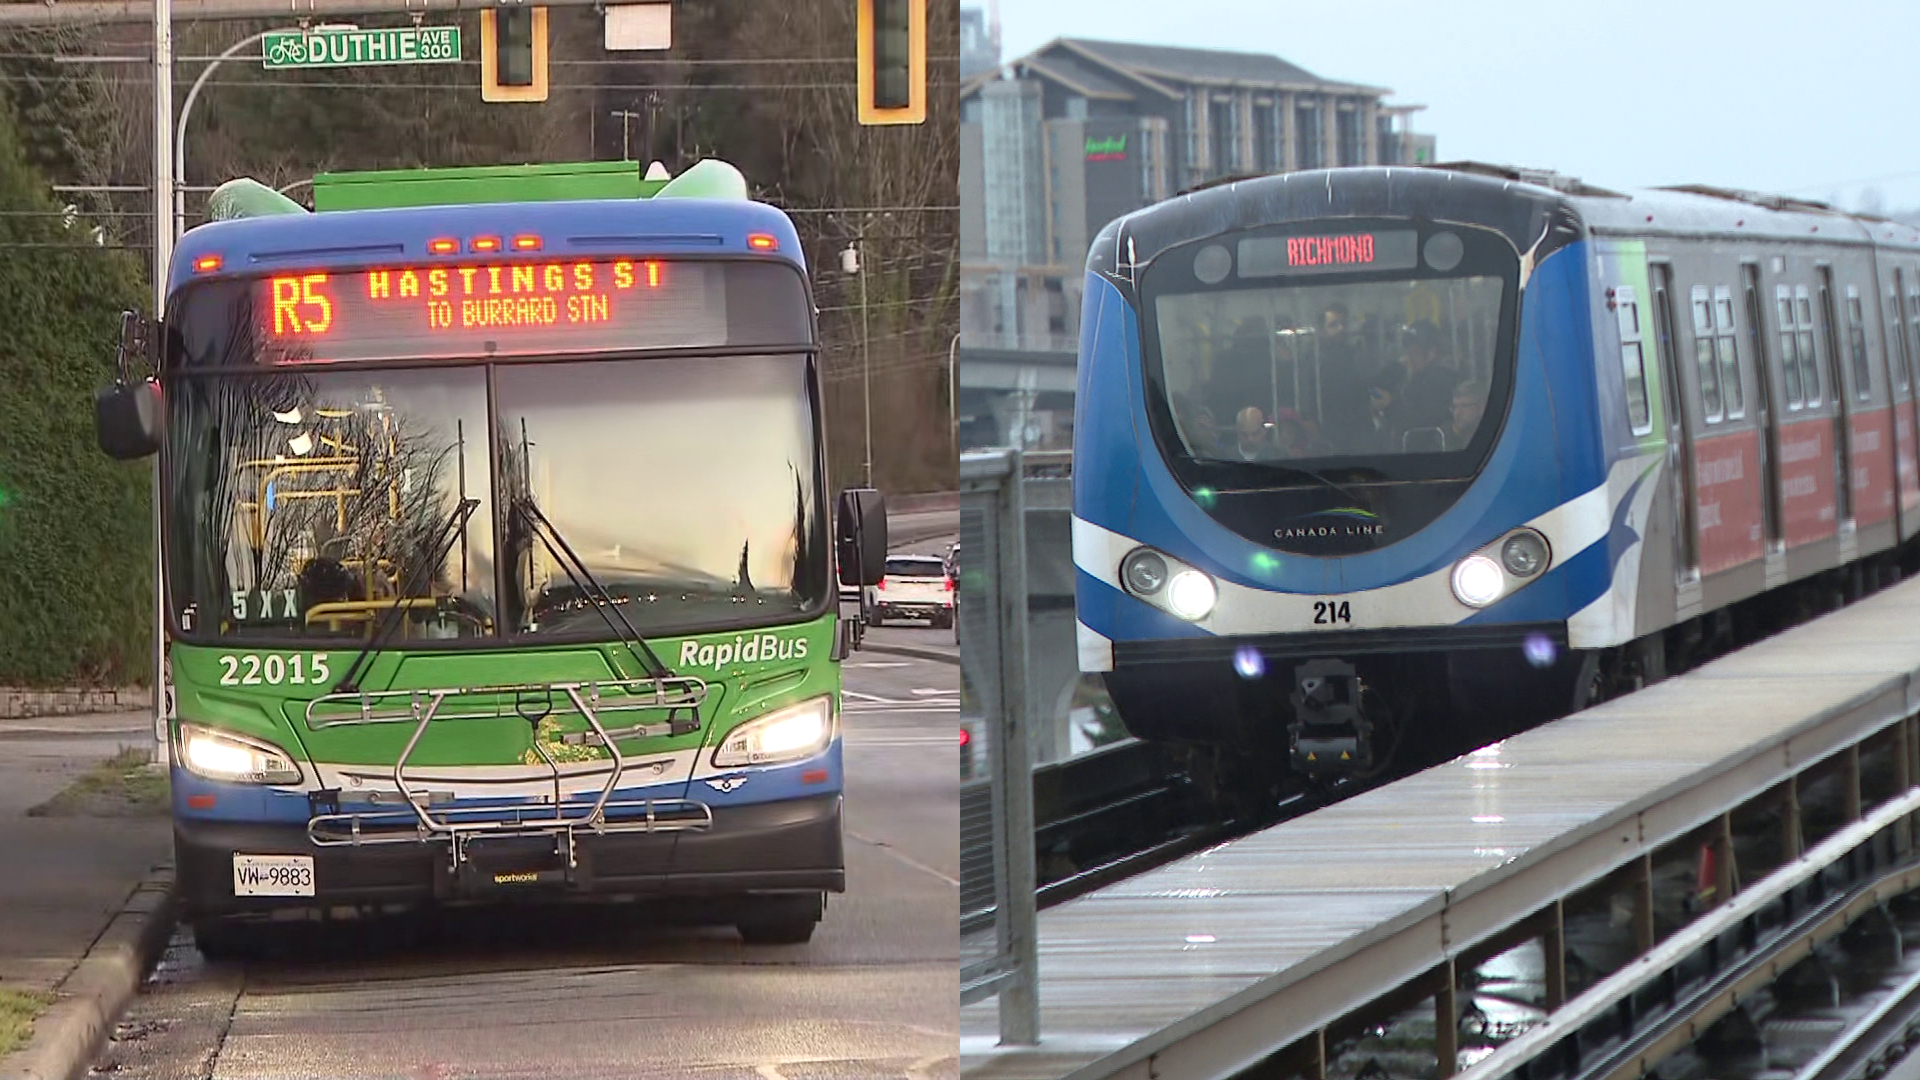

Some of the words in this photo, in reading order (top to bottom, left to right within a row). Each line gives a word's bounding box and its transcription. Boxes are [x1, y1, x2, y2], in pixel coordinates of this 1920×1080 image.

[308, 32, 417, 62] DUTHIE
[421, 31, 450, 44] AVE
[421, 45, 451, 58] 300
[1287, 233, 1374, 266] RICHMOND
[368, 263, 594, 298] HASTINGS
[272, 274, 333, 334] R5
[428, 301, 452, 328] TO
[462, 297, 557, 327] BURRARD
[567, 294, 609, 322] STN
[1274, 526, 1338, 538] CANADA
[1346, 525, 1384, 535] LINE
[1313, 601, 1351, 624] 214
[679, 634, 808, 671] RapidBus
[219, 653, 330, 685] 22015
